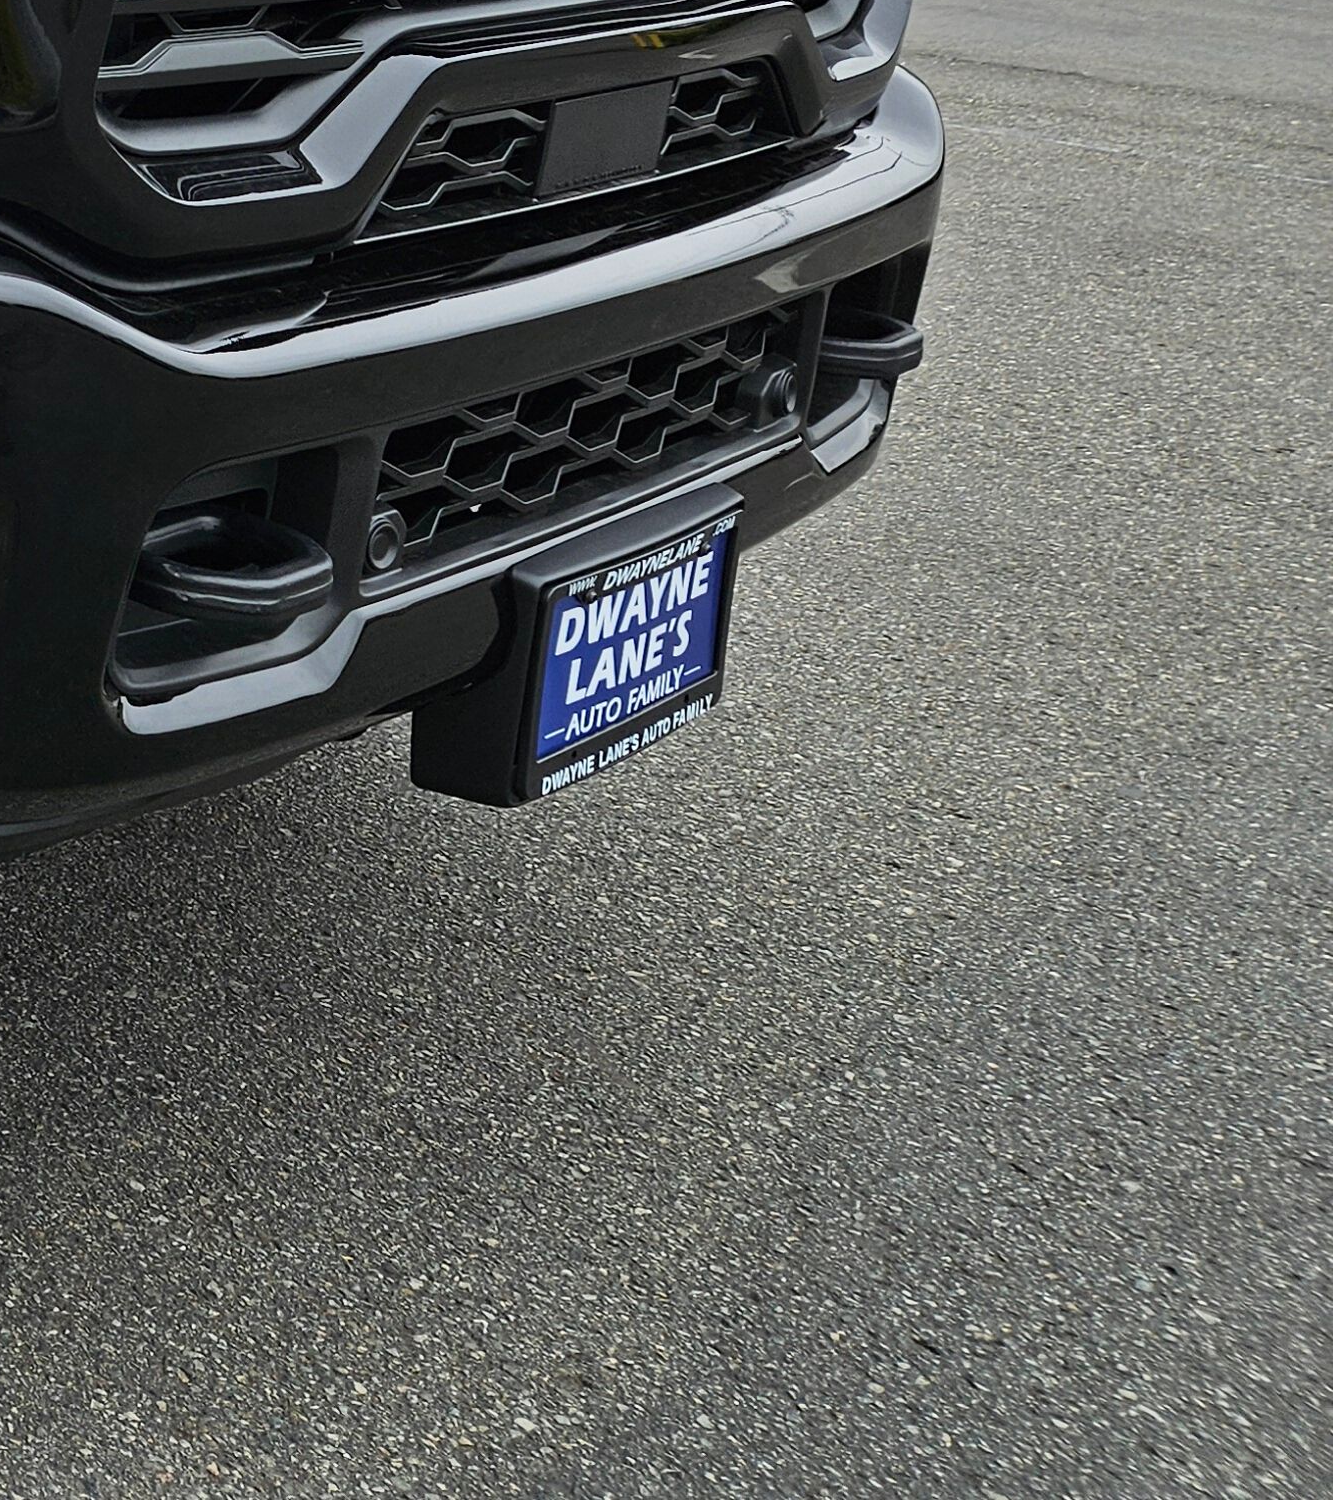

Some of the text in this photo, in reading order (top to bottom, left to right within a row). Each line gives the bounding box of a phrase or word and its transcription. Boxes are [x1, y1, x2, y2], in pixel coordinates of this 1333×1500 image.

[555, 551, 714, 656] DWAYNE
[602, 533, 705, 591] DWAYNELANE
[564, 664, 685, 741] AUTO FAMILY
[565, 610, 693, 705] LANE'S
[541, 693, 714, 796] DWAYNE LANE'S AUTO FAMILY
